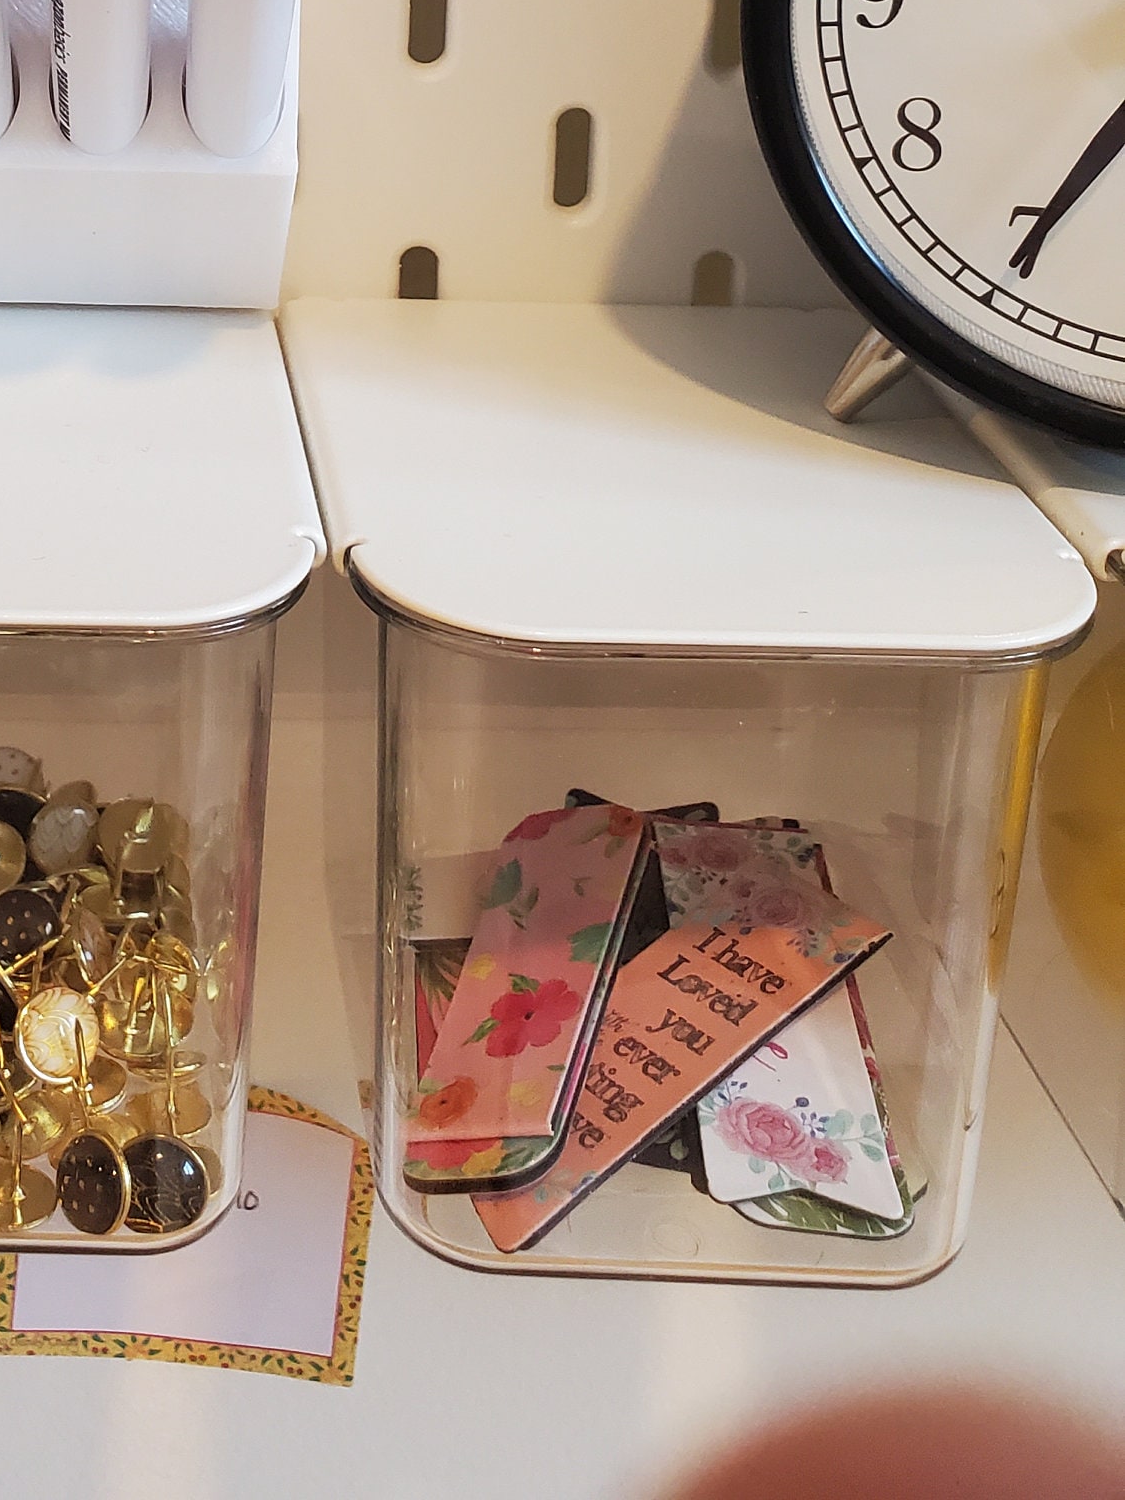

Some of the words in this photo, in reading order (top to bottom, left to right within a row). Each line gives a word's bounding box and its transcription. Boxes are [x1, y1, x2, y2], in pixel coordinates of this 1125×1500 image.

[892, 97, 943, 171] 8
[657, 954, 759, 1027] Loved
[710, 939, 786, 995] have
[645, 1008, 715, 1056] you
[613, 1036, 681, 1085] ever
